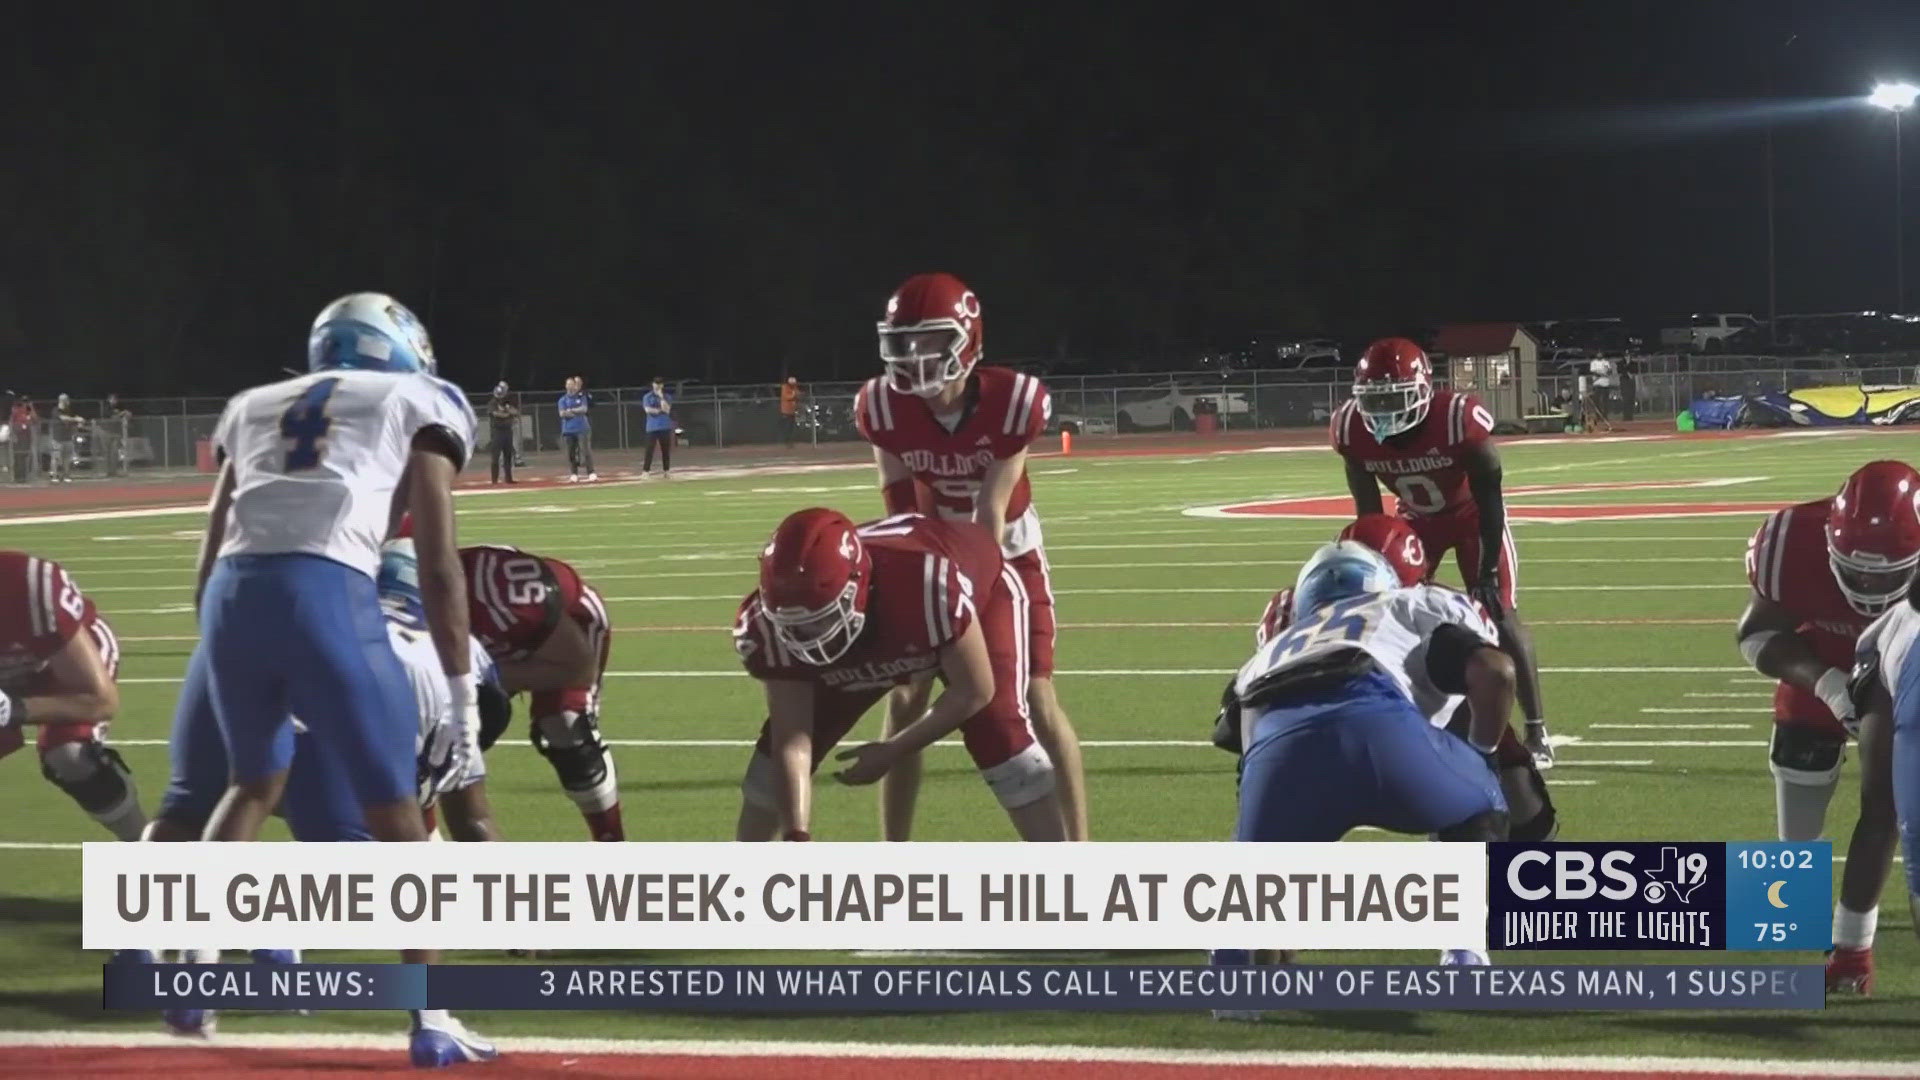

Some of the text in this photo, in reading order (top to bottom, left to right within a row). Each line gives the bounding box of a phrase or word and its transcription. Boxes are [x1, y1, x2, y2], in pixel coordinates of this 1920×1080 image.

[280, 377, 340, 475] 4
[1472, 404, 1495, 433] 0
[1395, 475, 1446, 513] 0
[503, 557, 546, 605] 50
